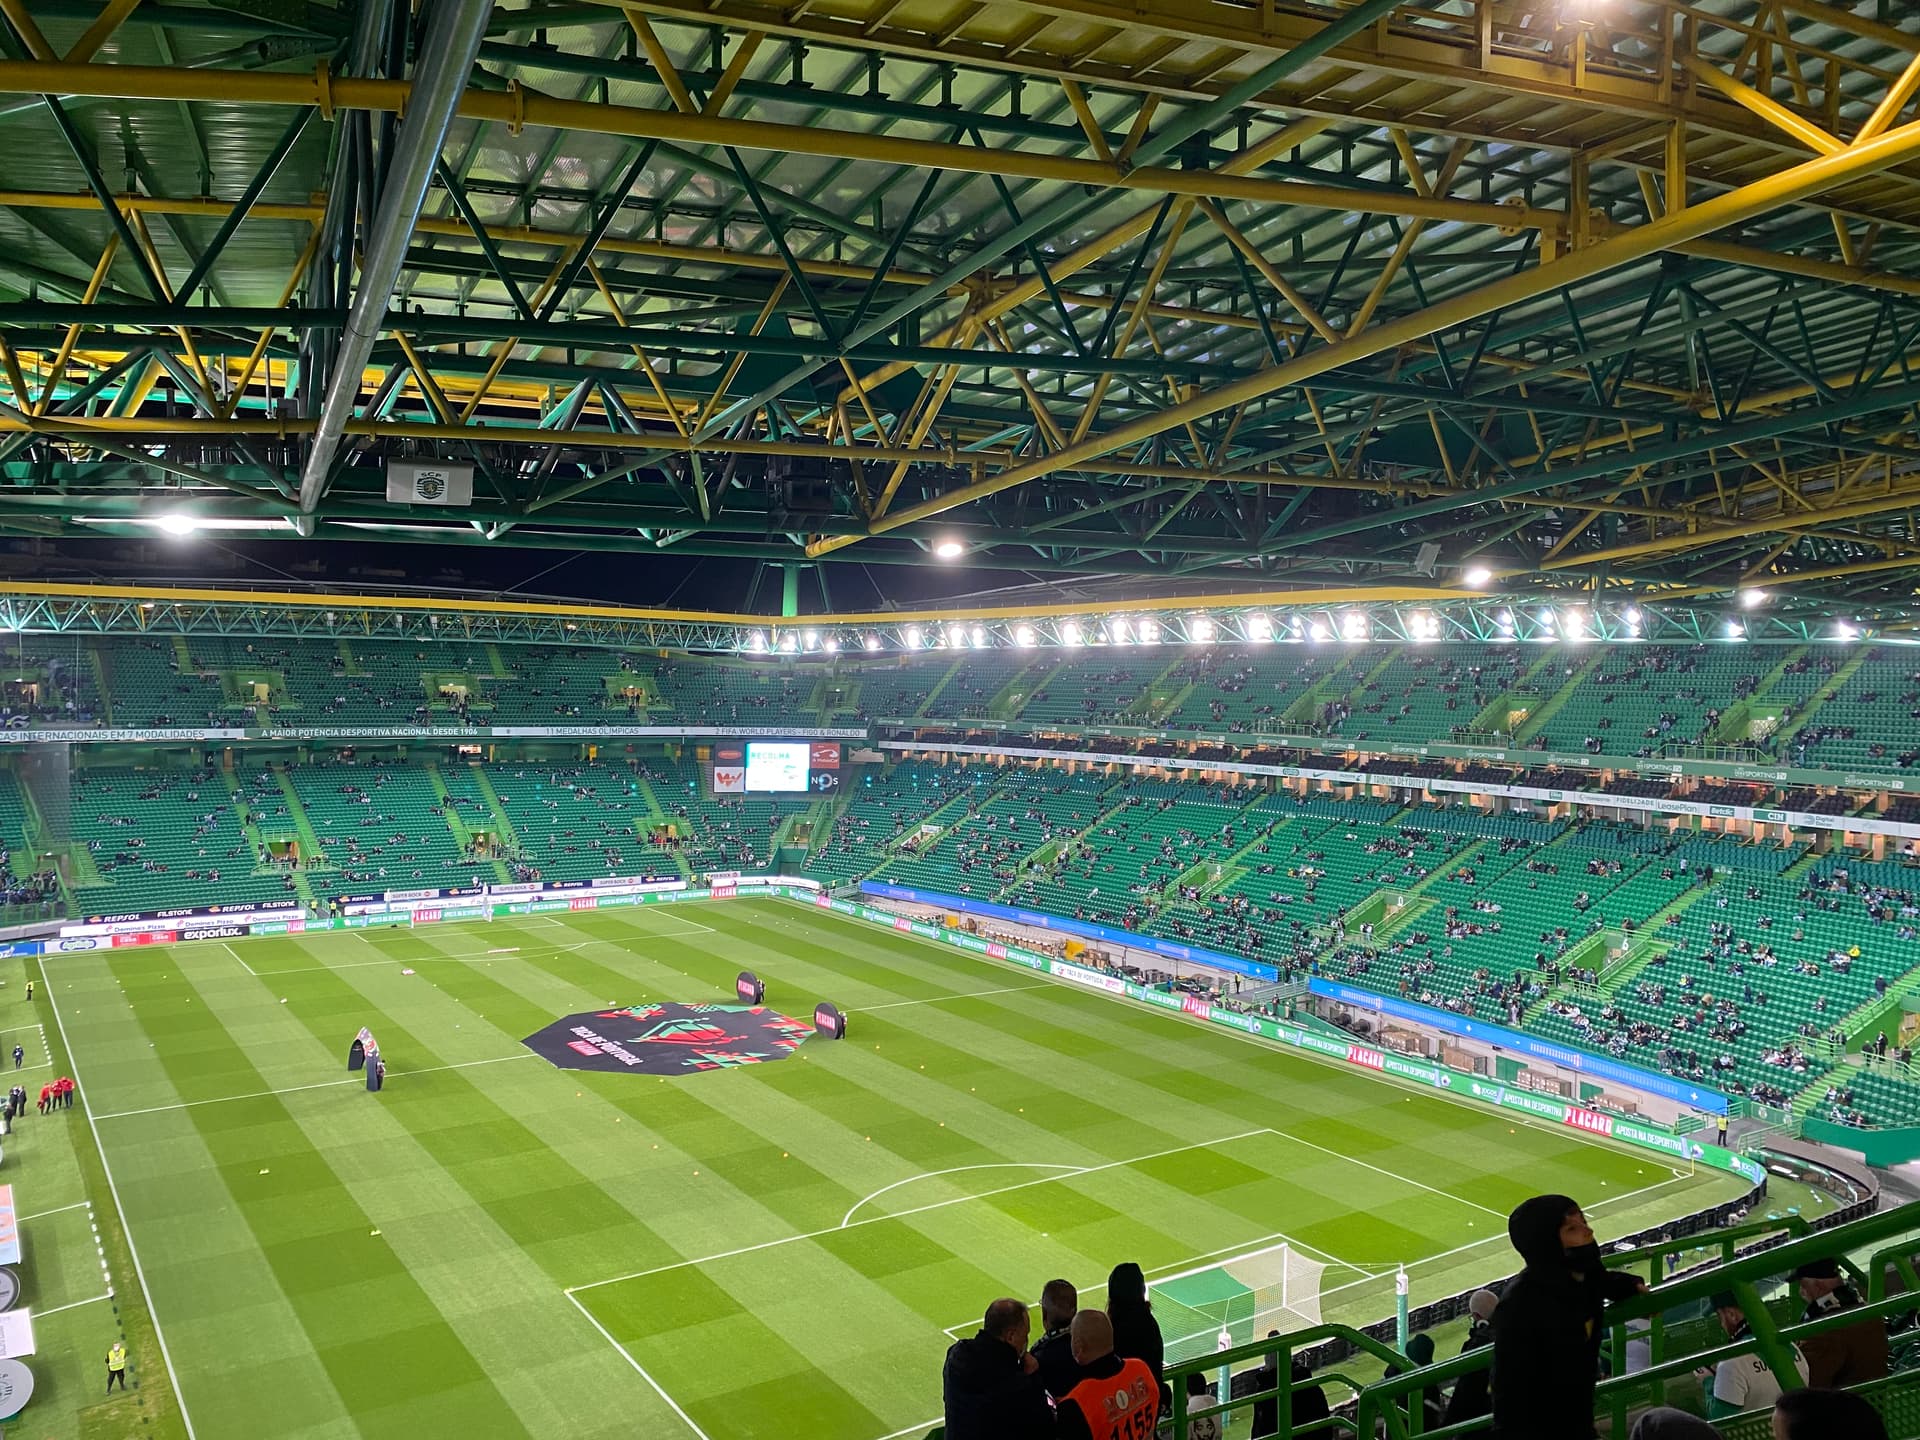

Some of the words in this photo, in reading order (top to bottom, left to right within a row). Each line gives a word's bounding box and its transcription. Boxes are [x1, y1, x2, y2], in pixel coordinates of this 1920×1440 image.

[20, 731, 108, 740] INTERNACIONAIS
[110, 730, 126, 739] EM
[127, 730, 134, 738] 7
[135, 730, 205, 738] MODALIDADES
[341, 728, 391, 736] DESPORTIVA
[739, 728, 765, 736] WORLD
[765, 728, 797, 736] PLAYERS
[826, 729, 860, 737] RONALDO
[1745, 770, 1776, 779] SPORTING
[1855, 779, 1891, 787] SPORTING
[1658, 801, 1697, 813] LeasePlan
[222, 904, 255, 912] REPSOL
[262, 901, 296, 909] FILSTONE
[157, 909, 193, 918] FILSTONE
[104, 914, 140, 923] REPSOL
[1348, 1046, 1384, 1068] PLACARD
[1504, 1094, 1524, 1107] APOSTA
[1524, 1098, 1531, 1108] NA
[1531, 1100, 1563, 1117] DESPORTIVA
[1565, 1107, 1612, 1134] PLACARD
[1616, 1124, 1638, 1140] APOSTA
[1638, 1131, 1647, 1141] NA
[1647, 1133, 1683, 1152] DESPORTIVA
